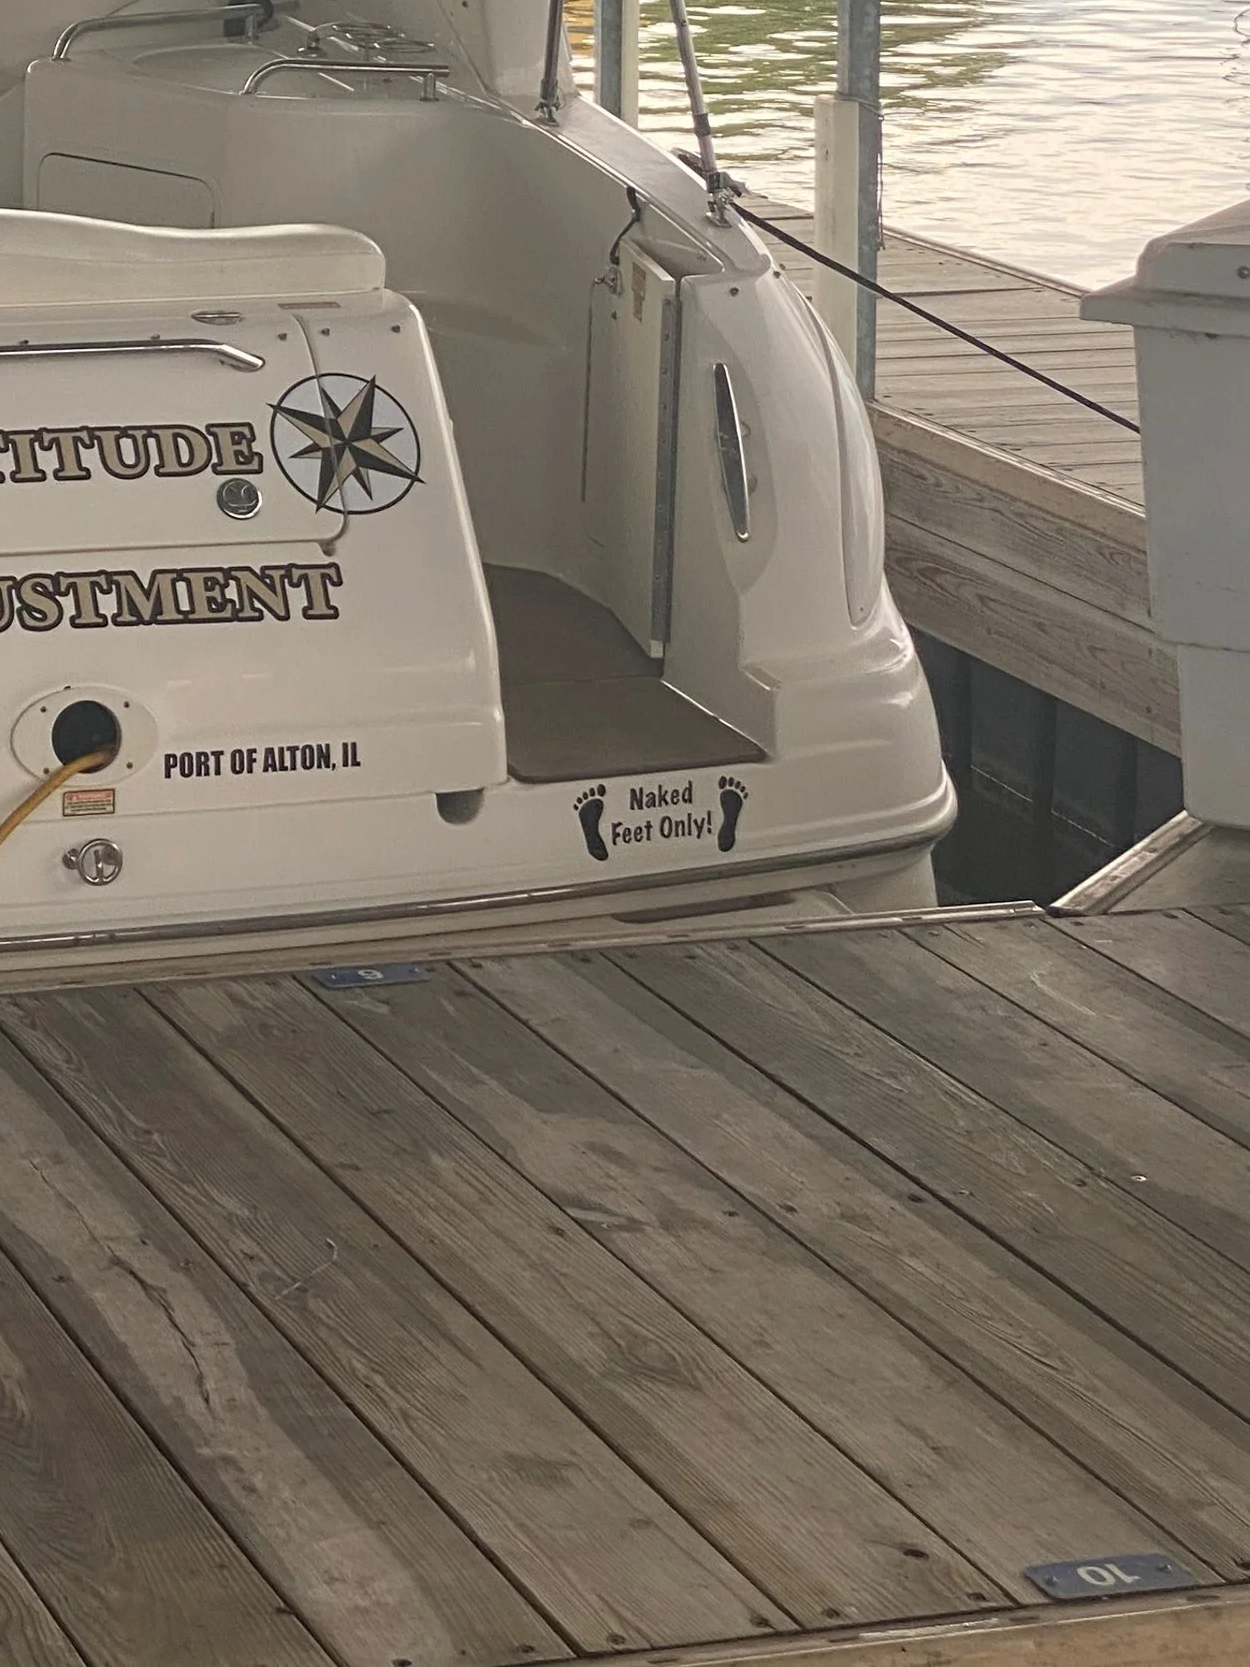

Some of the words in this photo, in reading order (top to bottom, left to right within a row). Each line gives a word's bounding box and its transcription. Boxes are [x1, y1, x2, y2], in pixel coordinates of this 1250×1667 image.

[164, 750, 224, 779] PORT
[230, 748, 258, 775] OF
[262, 742, 337, 773] ALTON,
[342, 741, 361, 768] IL
[629, 780, 693, 811] Naked
[611, 820, 652, 846] Feet
[659, 810, 713, 840] Only!
